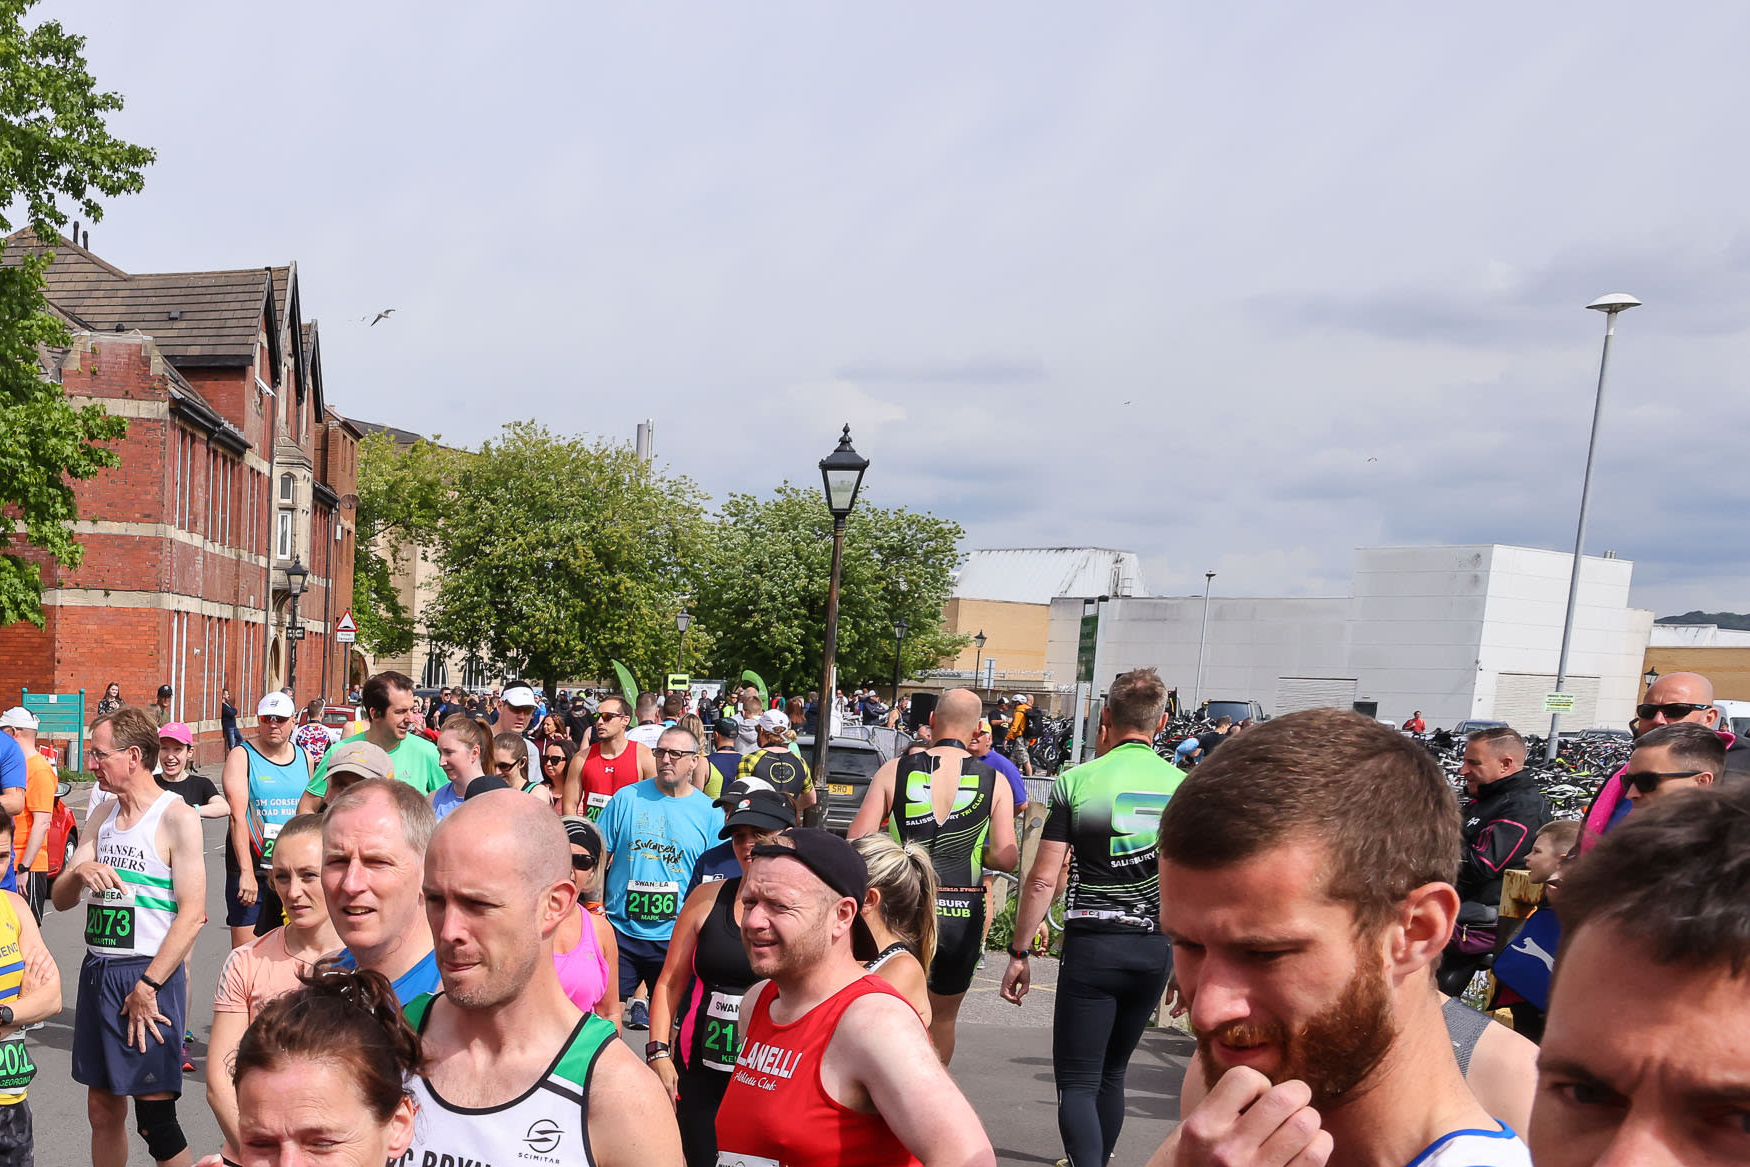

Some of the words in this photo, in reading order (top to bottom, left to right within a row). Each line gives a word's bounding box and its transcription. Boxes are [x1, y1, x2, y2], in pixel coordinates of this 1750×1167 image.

[628, 892, 675, 914] 2136
[87, 907, 131, 937] 2073
[737, 1037, 803, 1079] LANELLI
[518, 1152, 560, 1165] SCIMITAR
